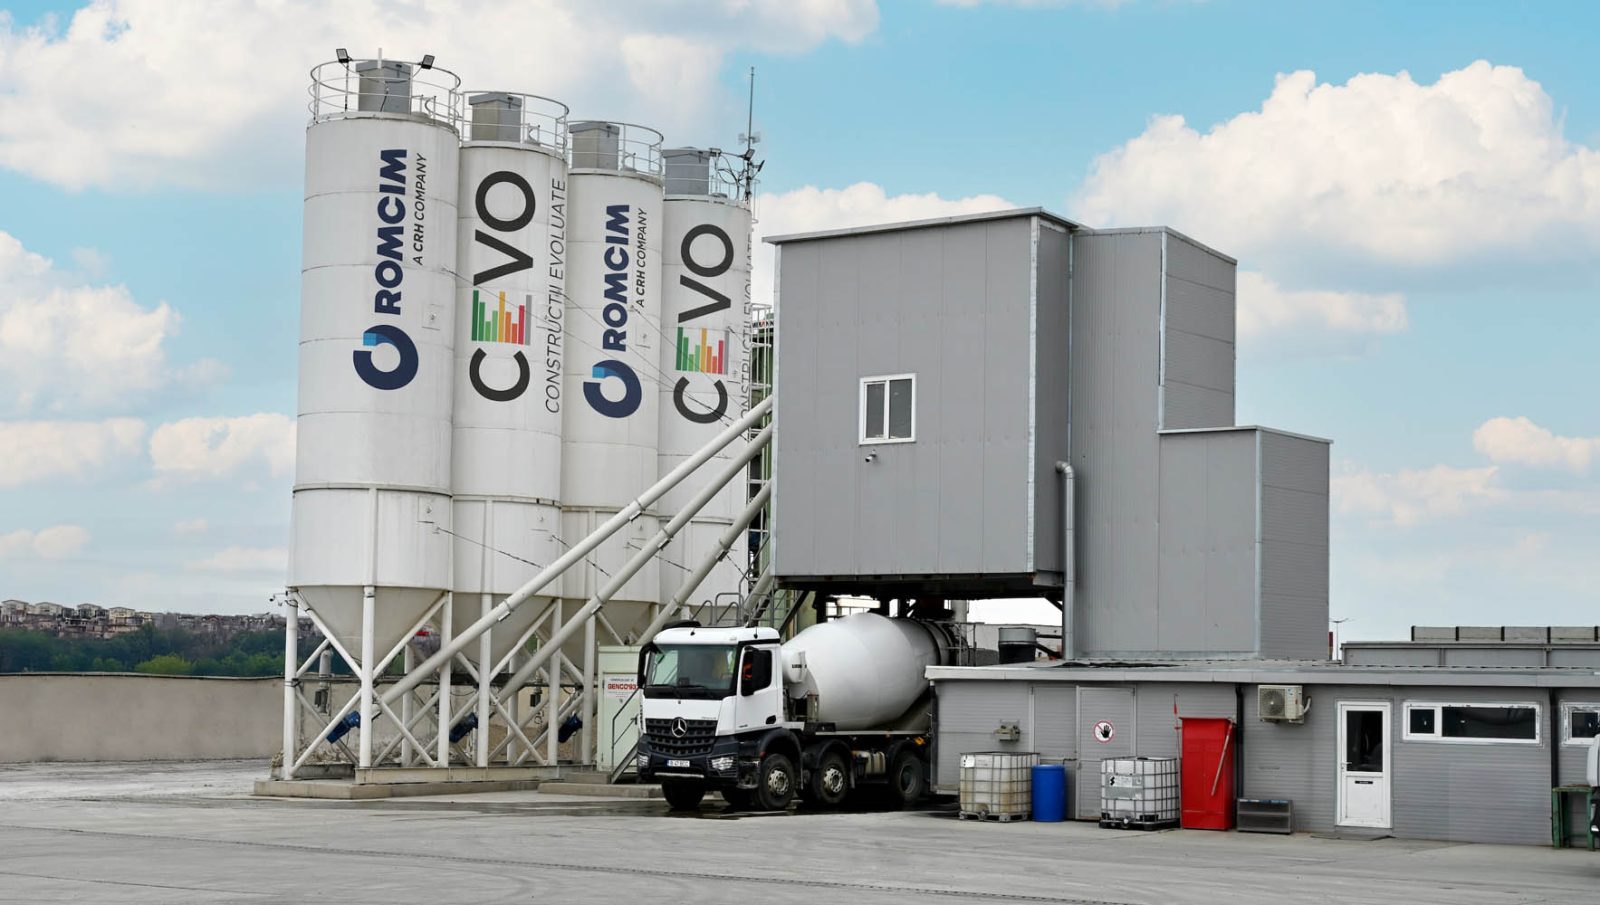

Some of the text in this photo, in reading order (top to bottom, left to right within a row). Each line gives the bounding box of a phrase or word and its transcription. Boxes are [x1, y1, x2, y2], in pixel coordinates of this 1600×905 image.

[375, 149, 408, 315] ROMCIM
[412, 152, 427, 266] A CRH COMPANY
[550, 178, 566, 280] EVOLUATE
[602, 204, 630, 352] ROMCIM
[635, 207, 648, 308] A CRH COMPANY
[469, 170, 536, 402] CEVO
[673, 224, 734, 424] CEVO
